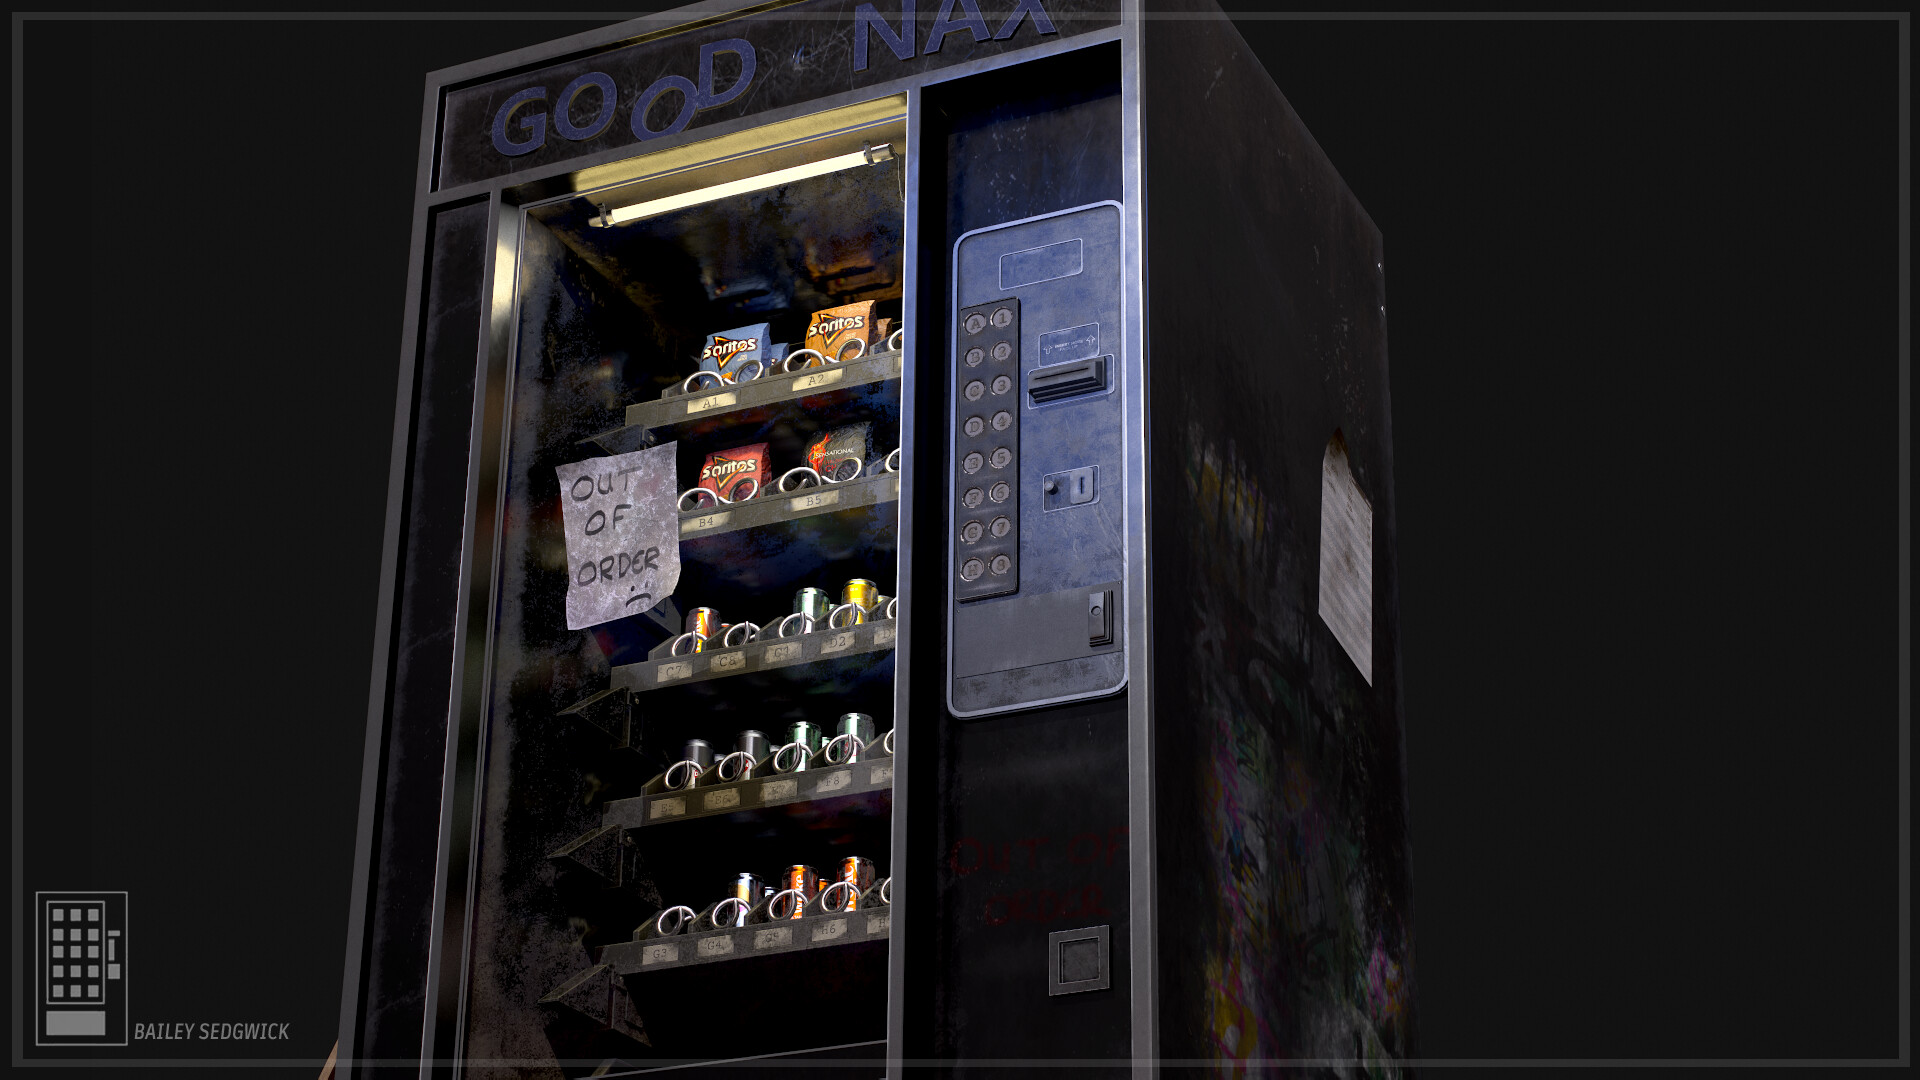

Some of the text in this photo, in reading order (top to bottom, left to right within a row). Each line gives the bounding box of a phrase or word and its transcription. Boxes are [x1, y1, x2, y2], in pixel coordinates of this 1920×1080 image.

[491, 38, 758, 157] GOOD
[808, 315, 865, 339] Soritos
[702, 337, 758, 361] Soritos
[808, 375, 825, 385] A2
[702, 397, 718, 408] A1
[702, 458, 757, 480] Soritos
[571, 466, 642, 501] OUT
[806, 496, 822, 506] B5
[585, 504, 632, 535] OF
[699, 517, 714, 527] B4
[578, 546, 660, 587] ORDER
[829, 637, 846, 648] D2
[666, 666, 682, 676] C7
[950, 837, 1050, 875] OUT
[985, 883, 1113, 926] ORDER
[652, 948, 667, 959] G3
